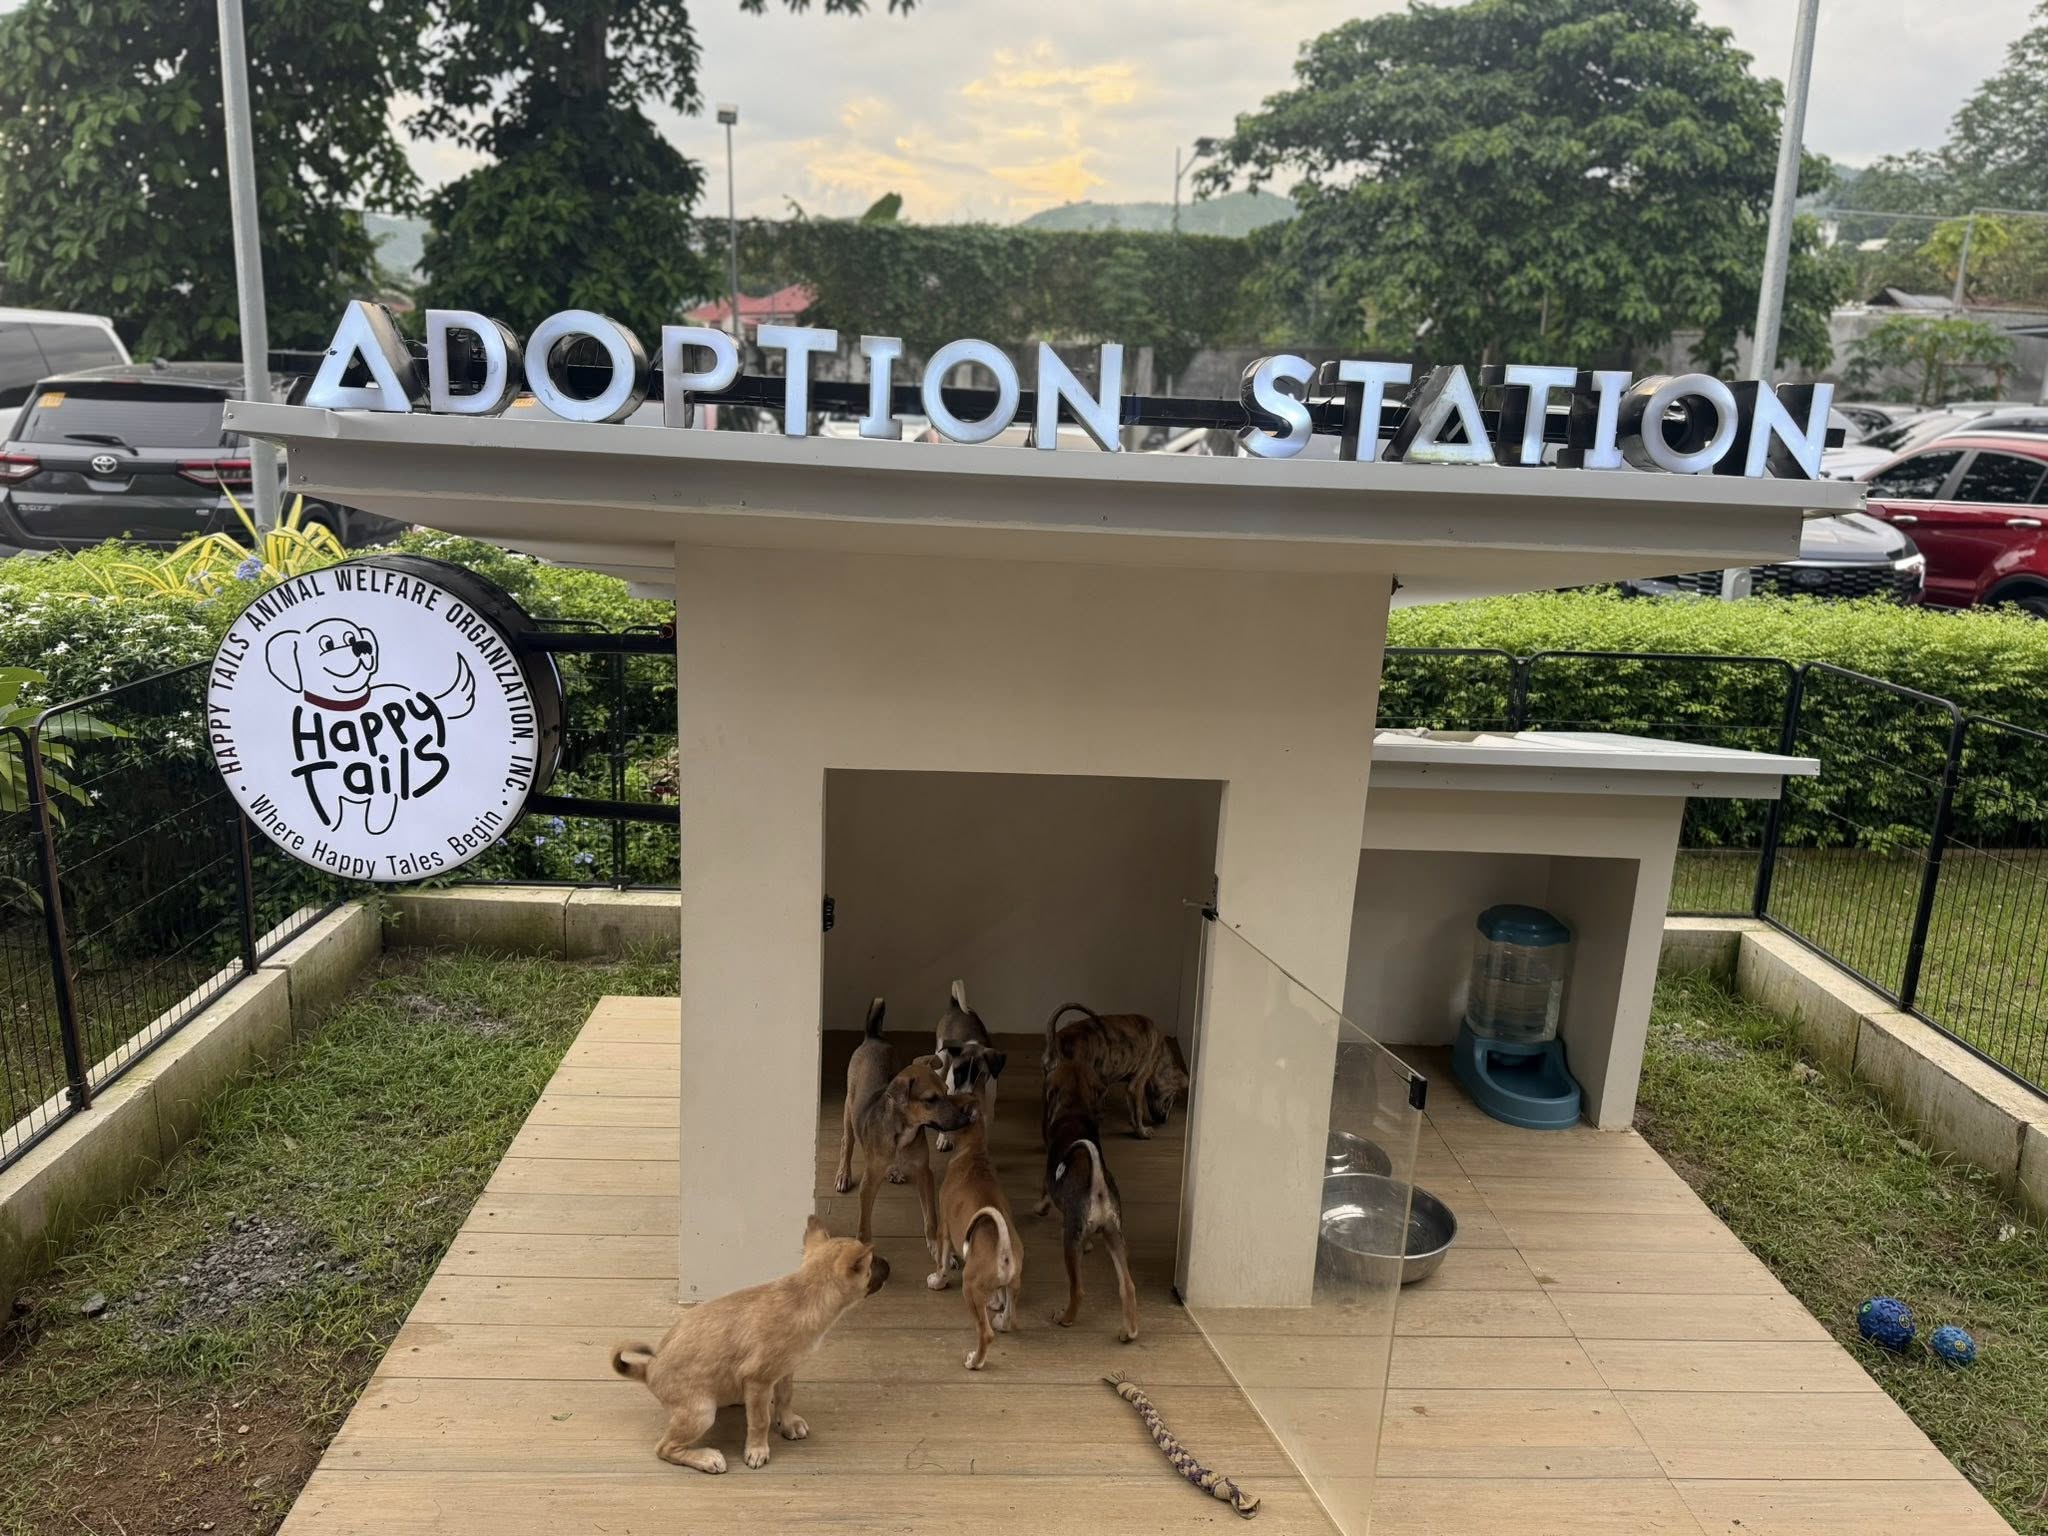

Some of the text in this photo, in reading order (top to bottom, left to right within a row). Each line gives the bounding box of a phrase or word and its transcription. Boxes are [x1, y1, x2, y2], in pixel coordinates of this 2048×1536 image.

[304, 299, 1834, 480] ADOPTION STATION
[245, 574, 326, 632] ANIMAL
[334, 568, 442, 611] WELFARE
[210, 631, 250, 692] TAILS
[207, 703, 243, 777] HAPPY
[292, 691, 446, 762] Happy
[291, 733, 450, 826] Tails
[502, 754, 534, 793] INC.
[249, 793, 503, 880] Where Happy Tales Begin
